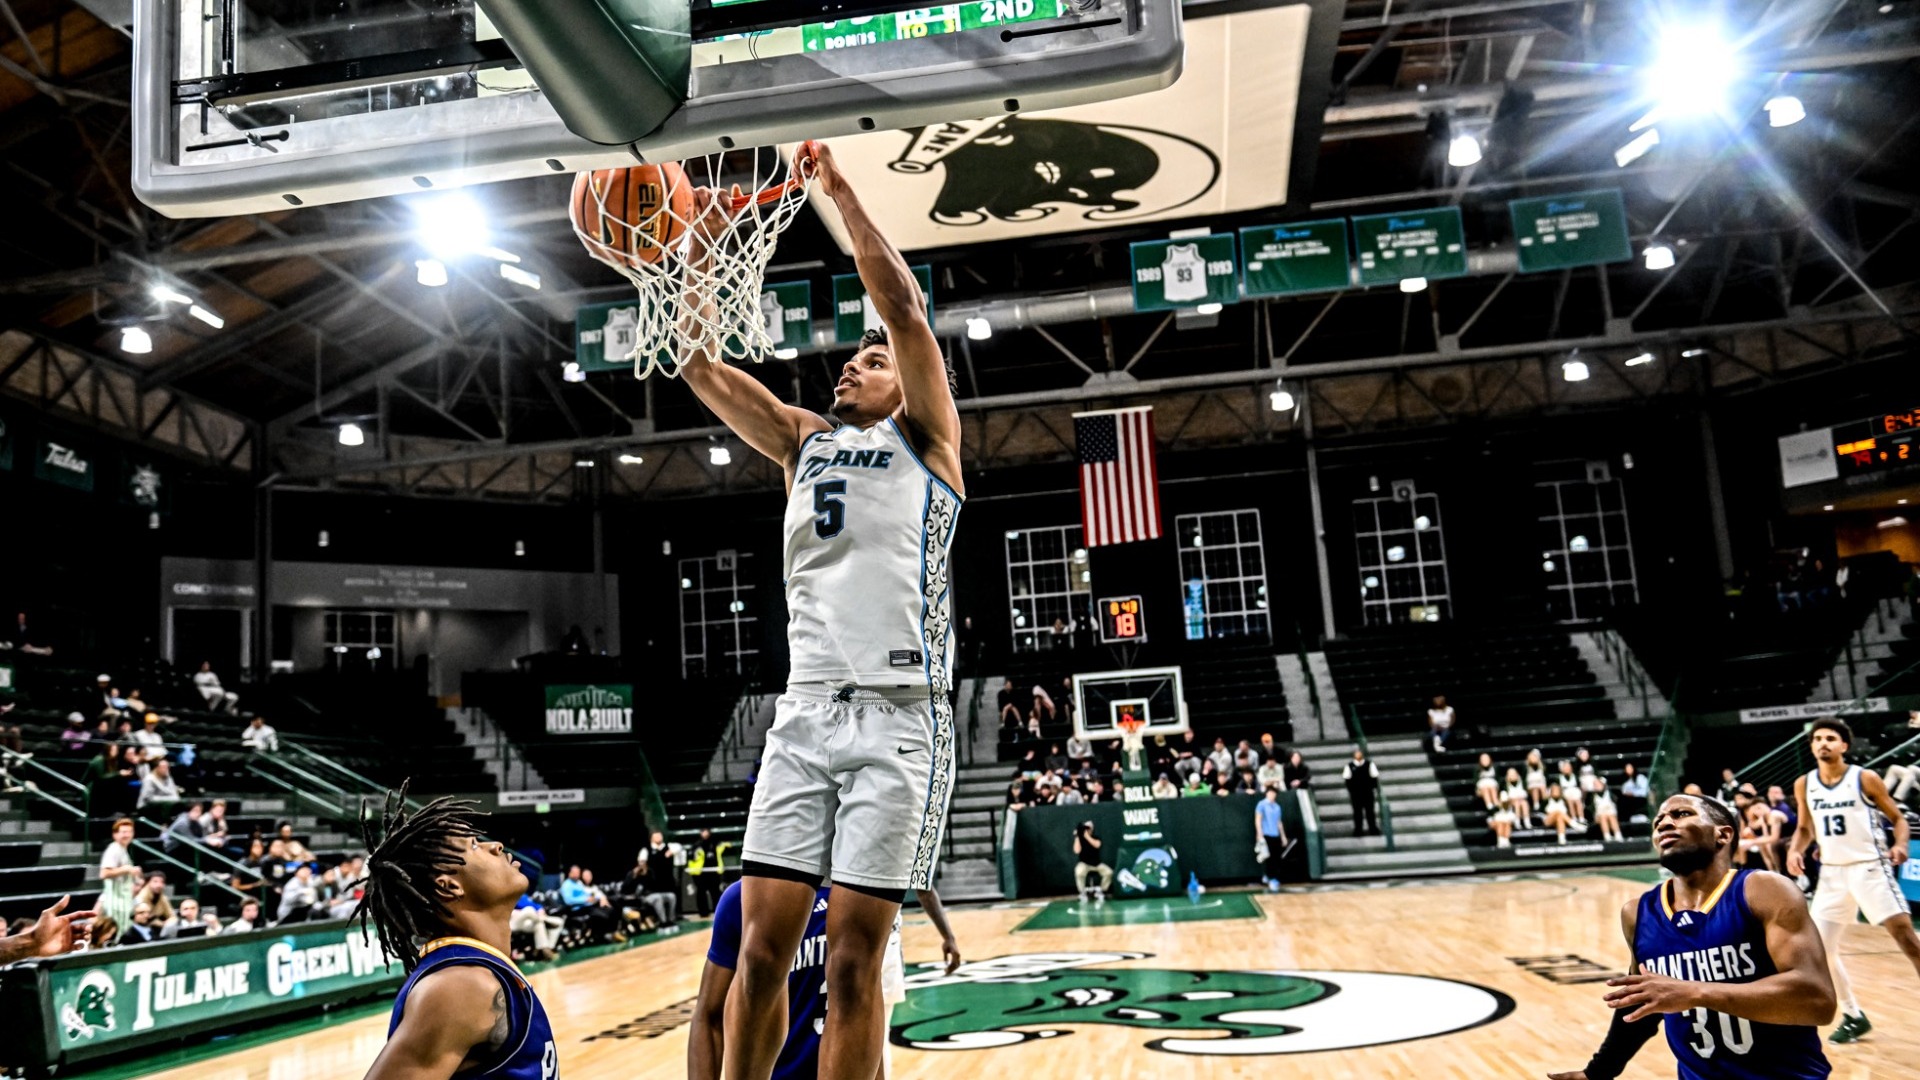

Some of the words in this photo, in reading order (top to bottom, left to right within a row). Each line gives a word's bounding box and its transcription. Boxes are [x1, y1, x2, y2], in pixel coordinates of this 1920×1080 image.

[980, 0, 1034, 23] 2ND
[825, 31, 876, 49] BONUS
[902, 22, 928, 39] TO
[1177, 267, 1193, 283] 93
[617, 330, 630, 345] 31
[798, 449, 895, 484] TUANE
[813, 478, 848, 541] 5
[1116, 612, 1137, 637] 18
[1123, 785, 1153, 803] ROLL
[1812, 798, 1856, 810] TULANE
[1122, 807, 1160, 826] WAVE
[1823, 814, 1848, 837] 13
[124, 956, 250, 1031] TULANE
[1681, 1006, 1754, 1058] 30
